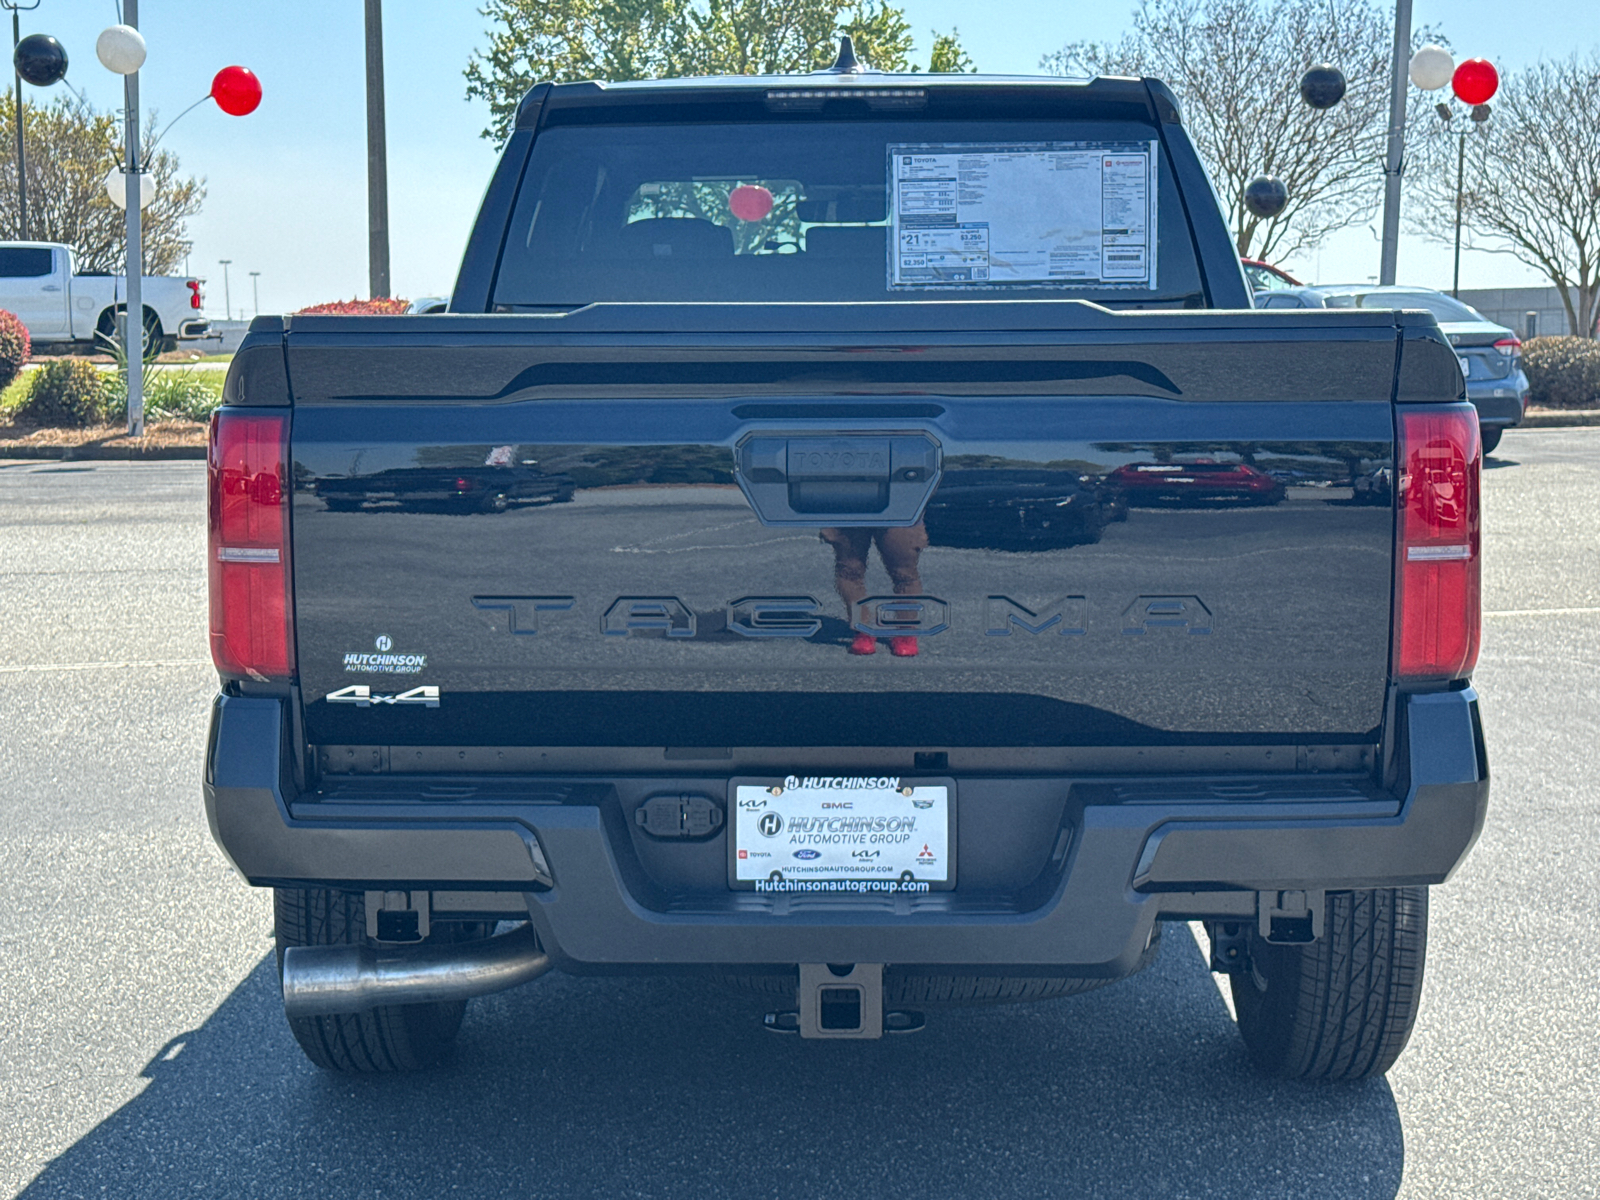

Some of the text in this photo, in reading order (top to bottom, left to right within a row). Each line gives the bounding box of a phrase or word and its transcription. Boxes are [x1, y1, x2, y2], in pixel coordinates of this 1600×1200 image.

[906, 234, 920, 245] 21
[793, 452, 886, 468] TOYOTA
[470, 594, 1214, 638] TACOMA
[344, 654, 425, 666] HUTCHINSON
[326, 684, 440, 708] 4x4
[802, 776, 900, 790] HUTCHINSON
[787, 816, 916, 833] HUTCHINSON
[789, 834, 910, 844] AUTOMOTIVE GROUP
[755, 880, 930, 893] Hutchinsonautogroup.com
